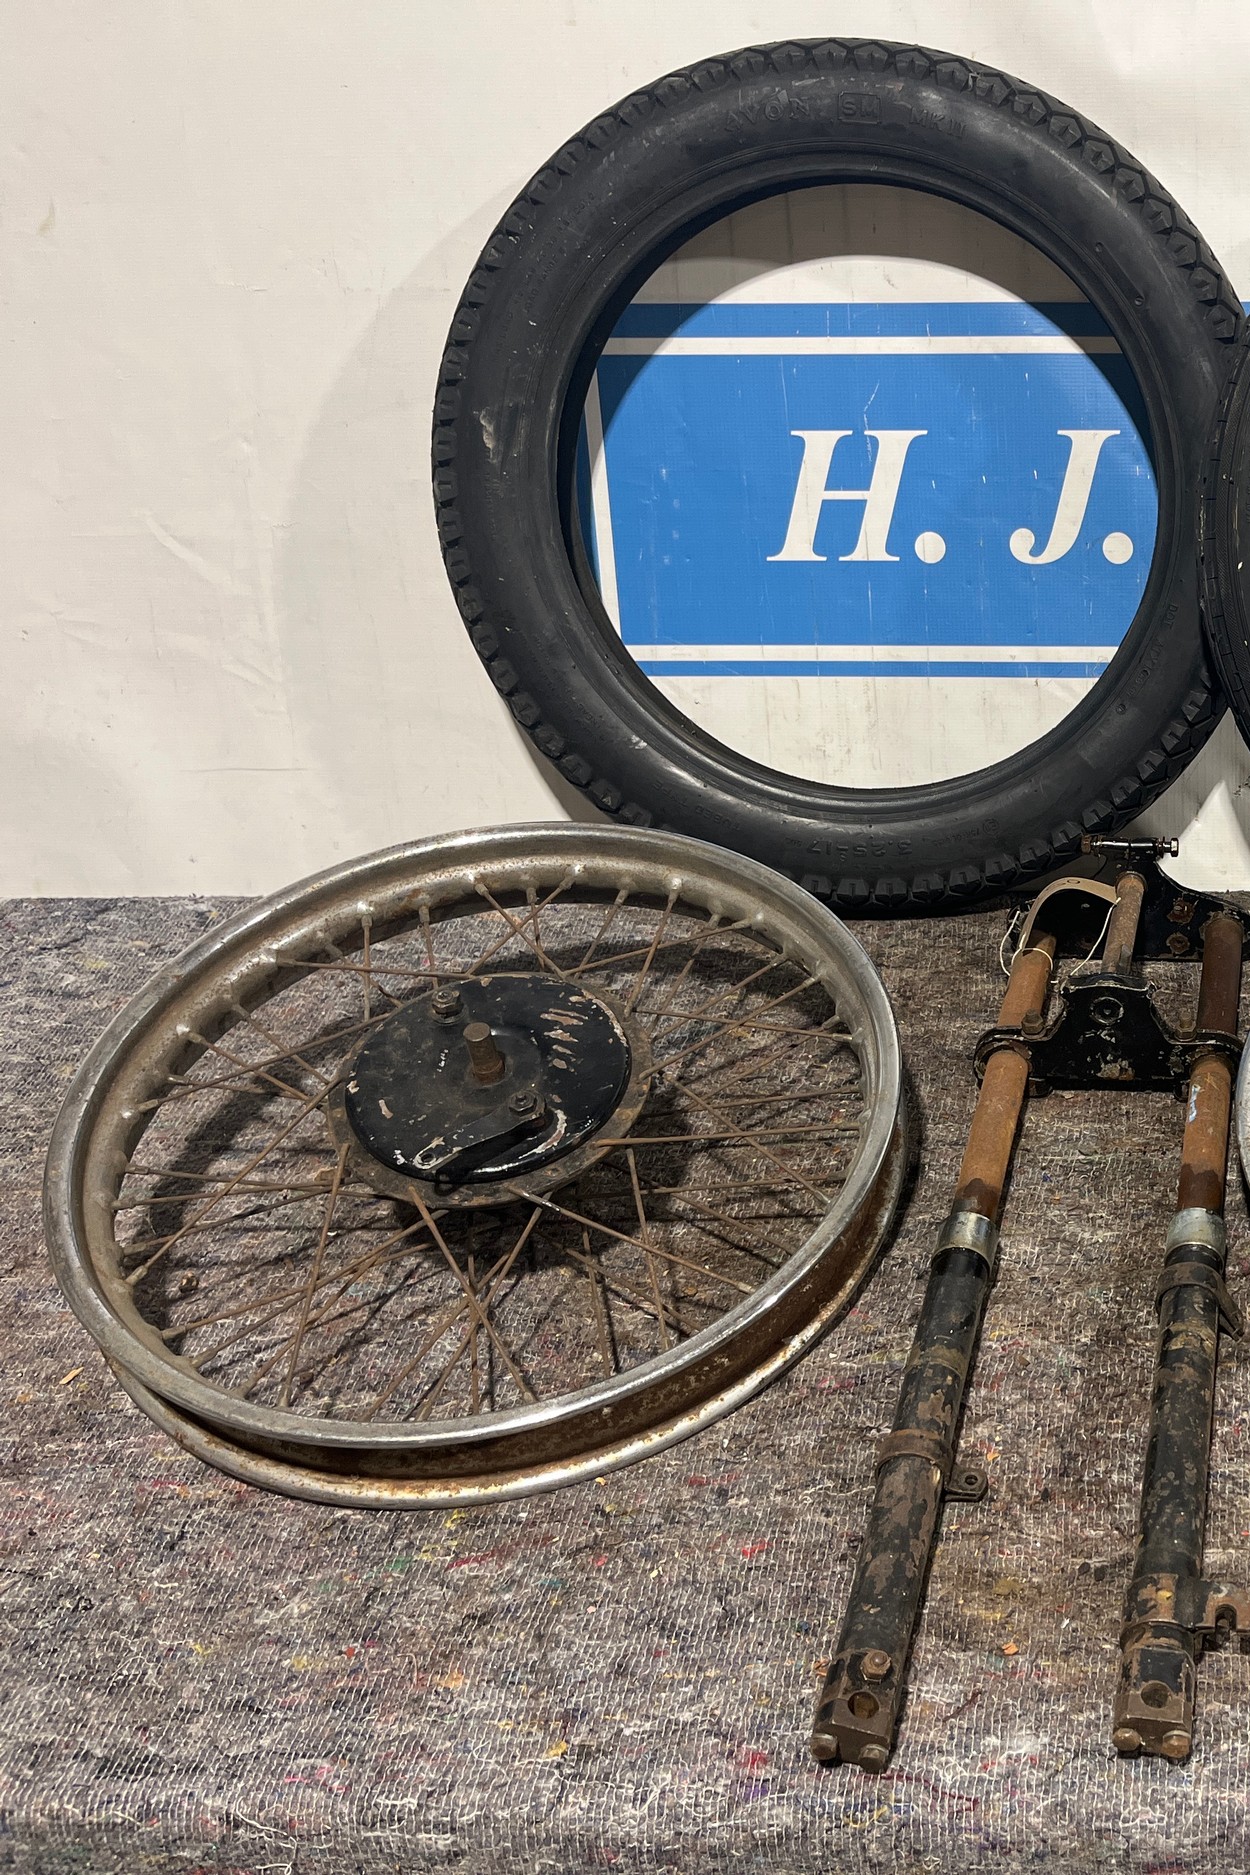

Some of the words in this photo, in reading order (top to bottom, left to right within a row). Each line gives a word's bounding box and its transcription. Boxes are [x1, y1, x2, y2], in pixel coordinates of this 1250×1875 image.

[839, 95, 882, 119] SM
[766, 429, 947, 564] H.
[1010, 429, 1135, 564] J.
